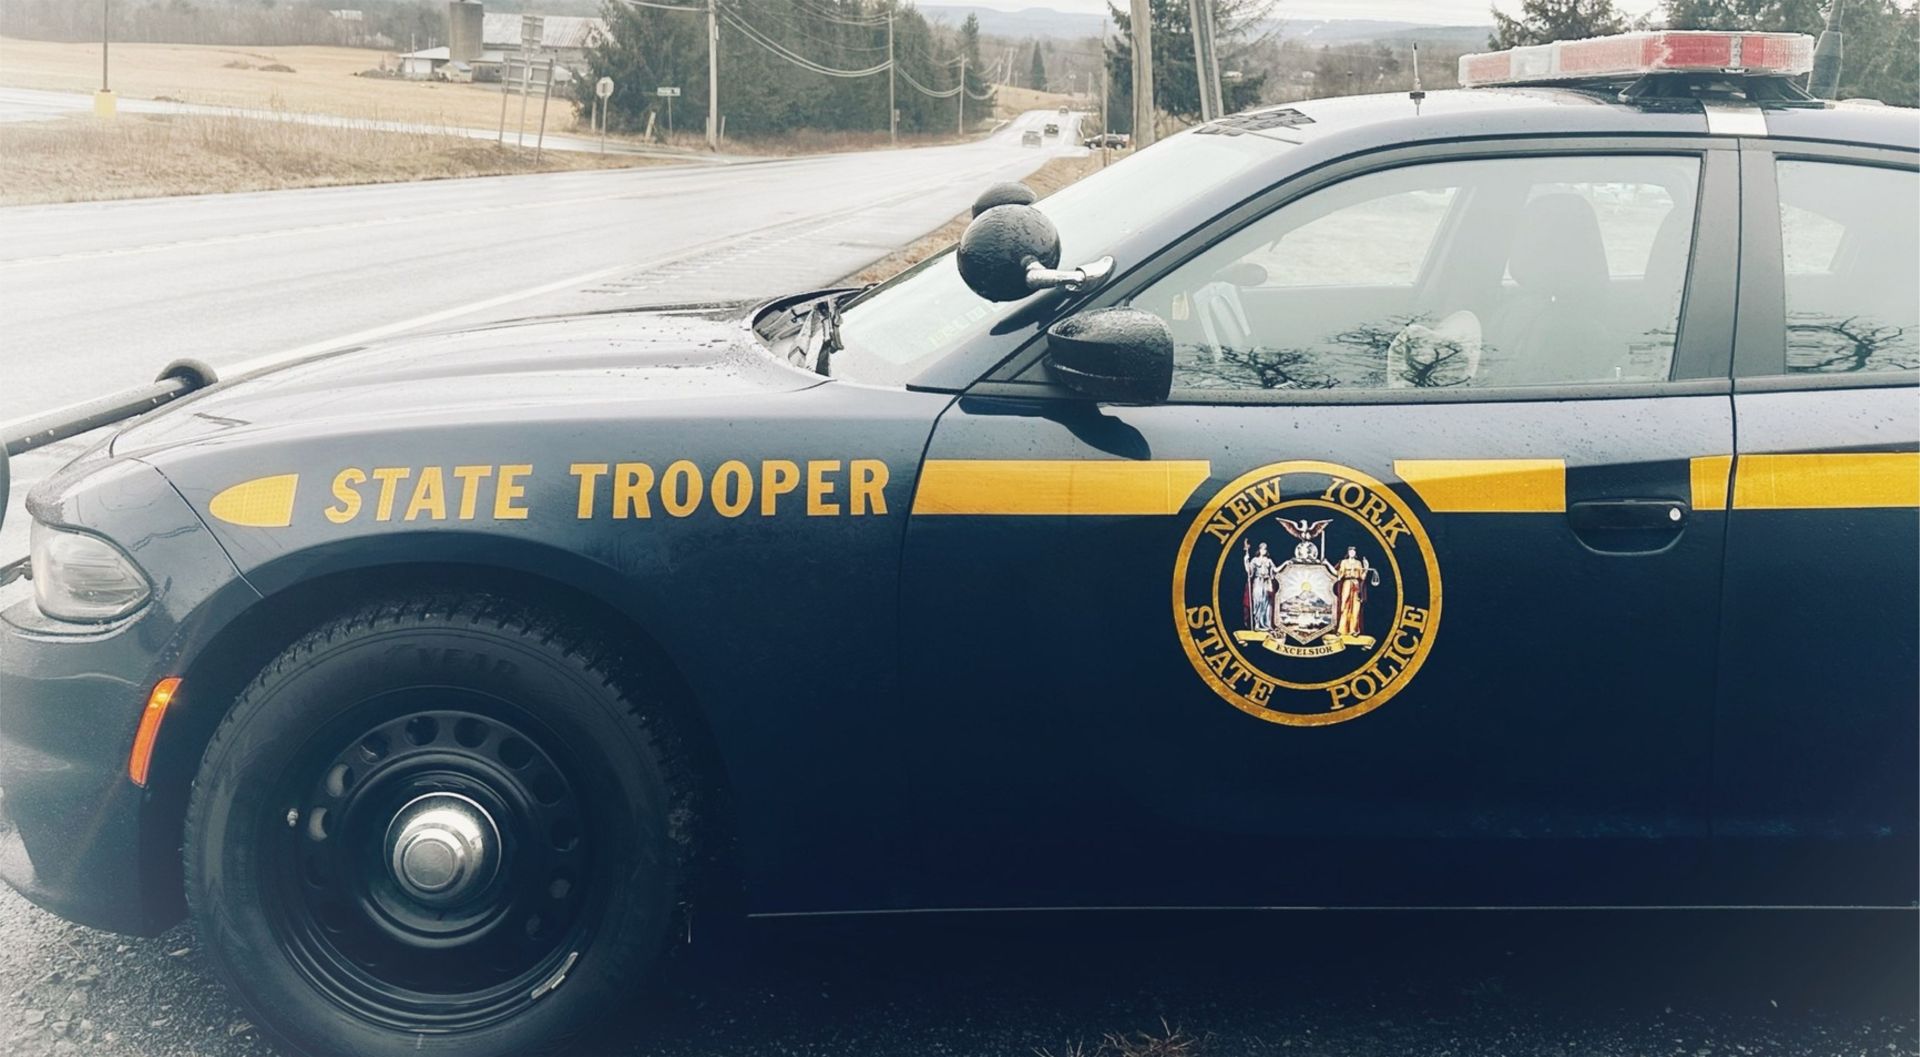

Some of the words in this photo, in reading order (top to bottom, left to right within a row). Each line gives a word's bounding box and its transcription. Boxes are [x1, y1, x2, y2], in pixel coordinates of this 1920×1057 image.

[324, 463, 533, 524] STATE
[570, 459, 890, 519] TROOPER
[1204, 477, 1282, 544] NEW
[1186, 604, 1276, 708] STATE
[1326, 604, 1429, 711] POLICE
[1275, 644, 1334, 656] EXCELSIOR
